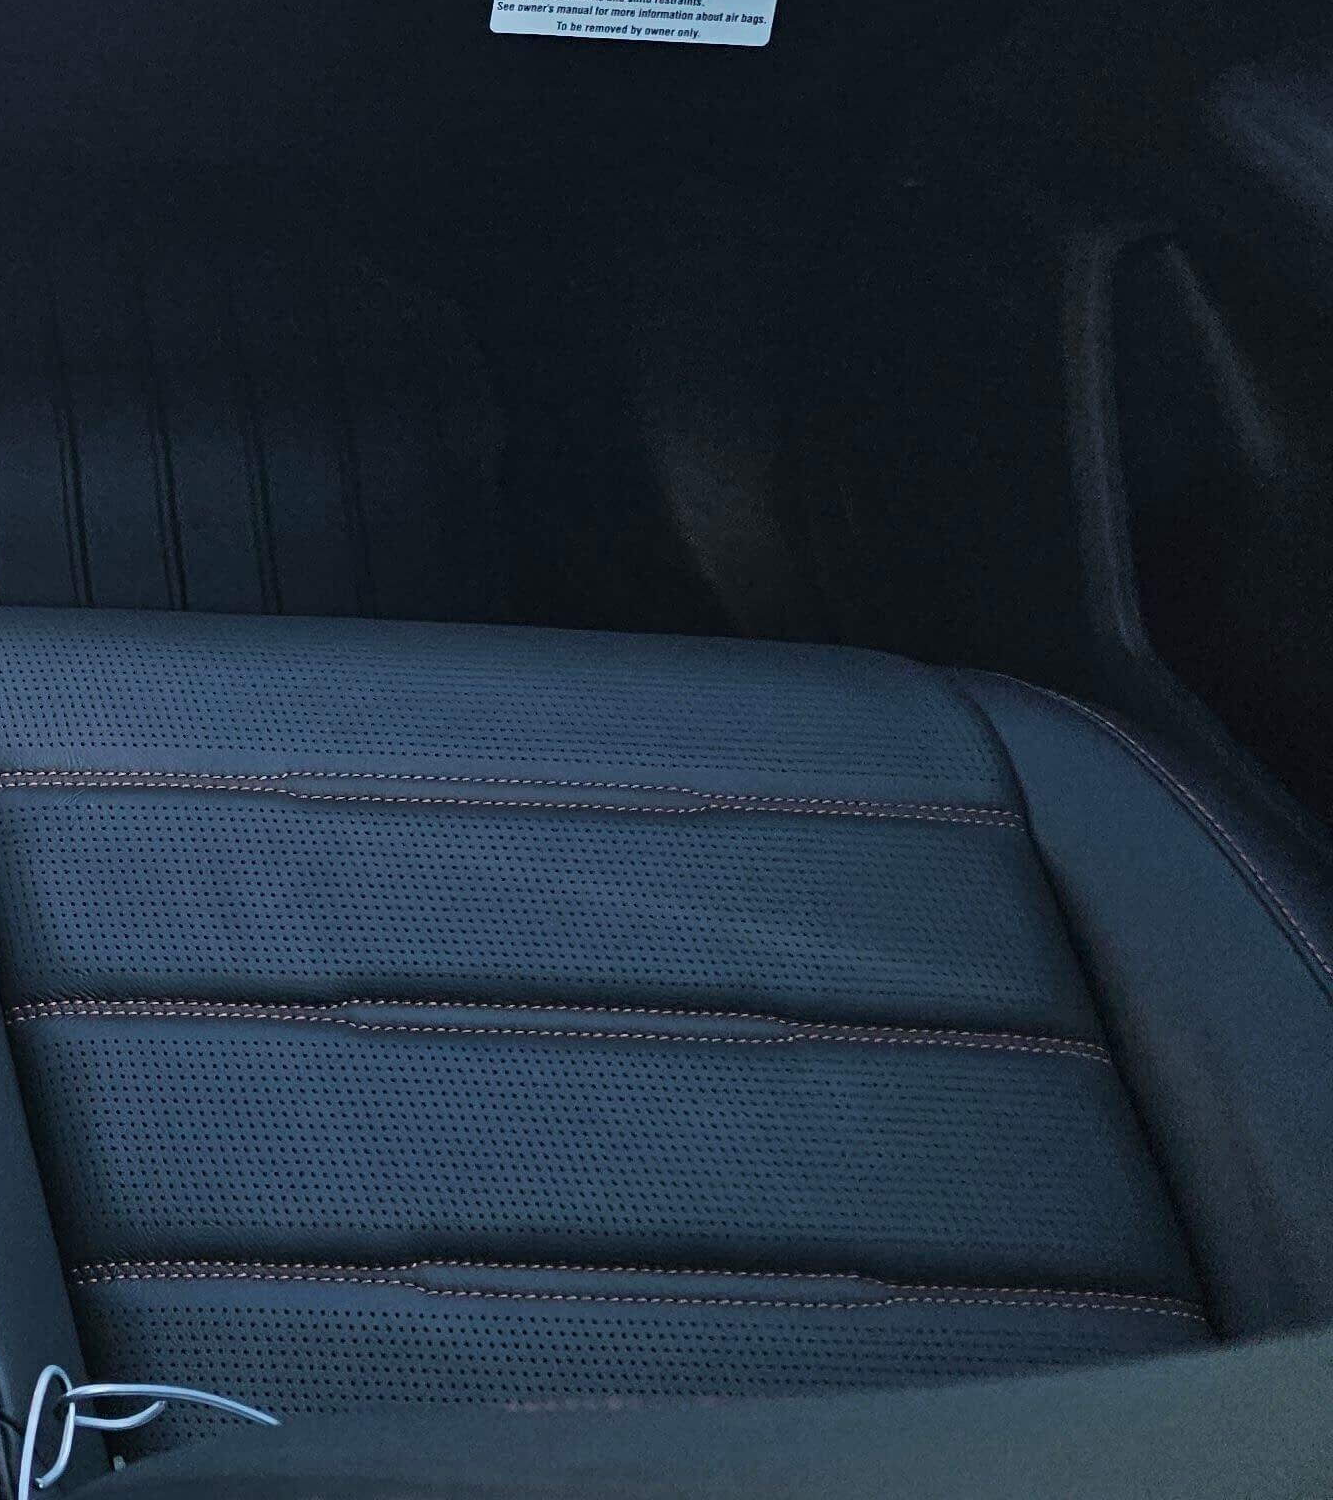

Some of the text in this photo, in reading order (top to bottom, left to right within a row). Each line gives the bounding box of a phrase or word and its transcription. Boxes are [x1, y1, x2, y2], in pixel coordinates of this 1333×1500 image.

[496, 1, 767, 25] See owner's manual for more information about air bags.
[556, 21, 700, 39] To be removed by owner only.
